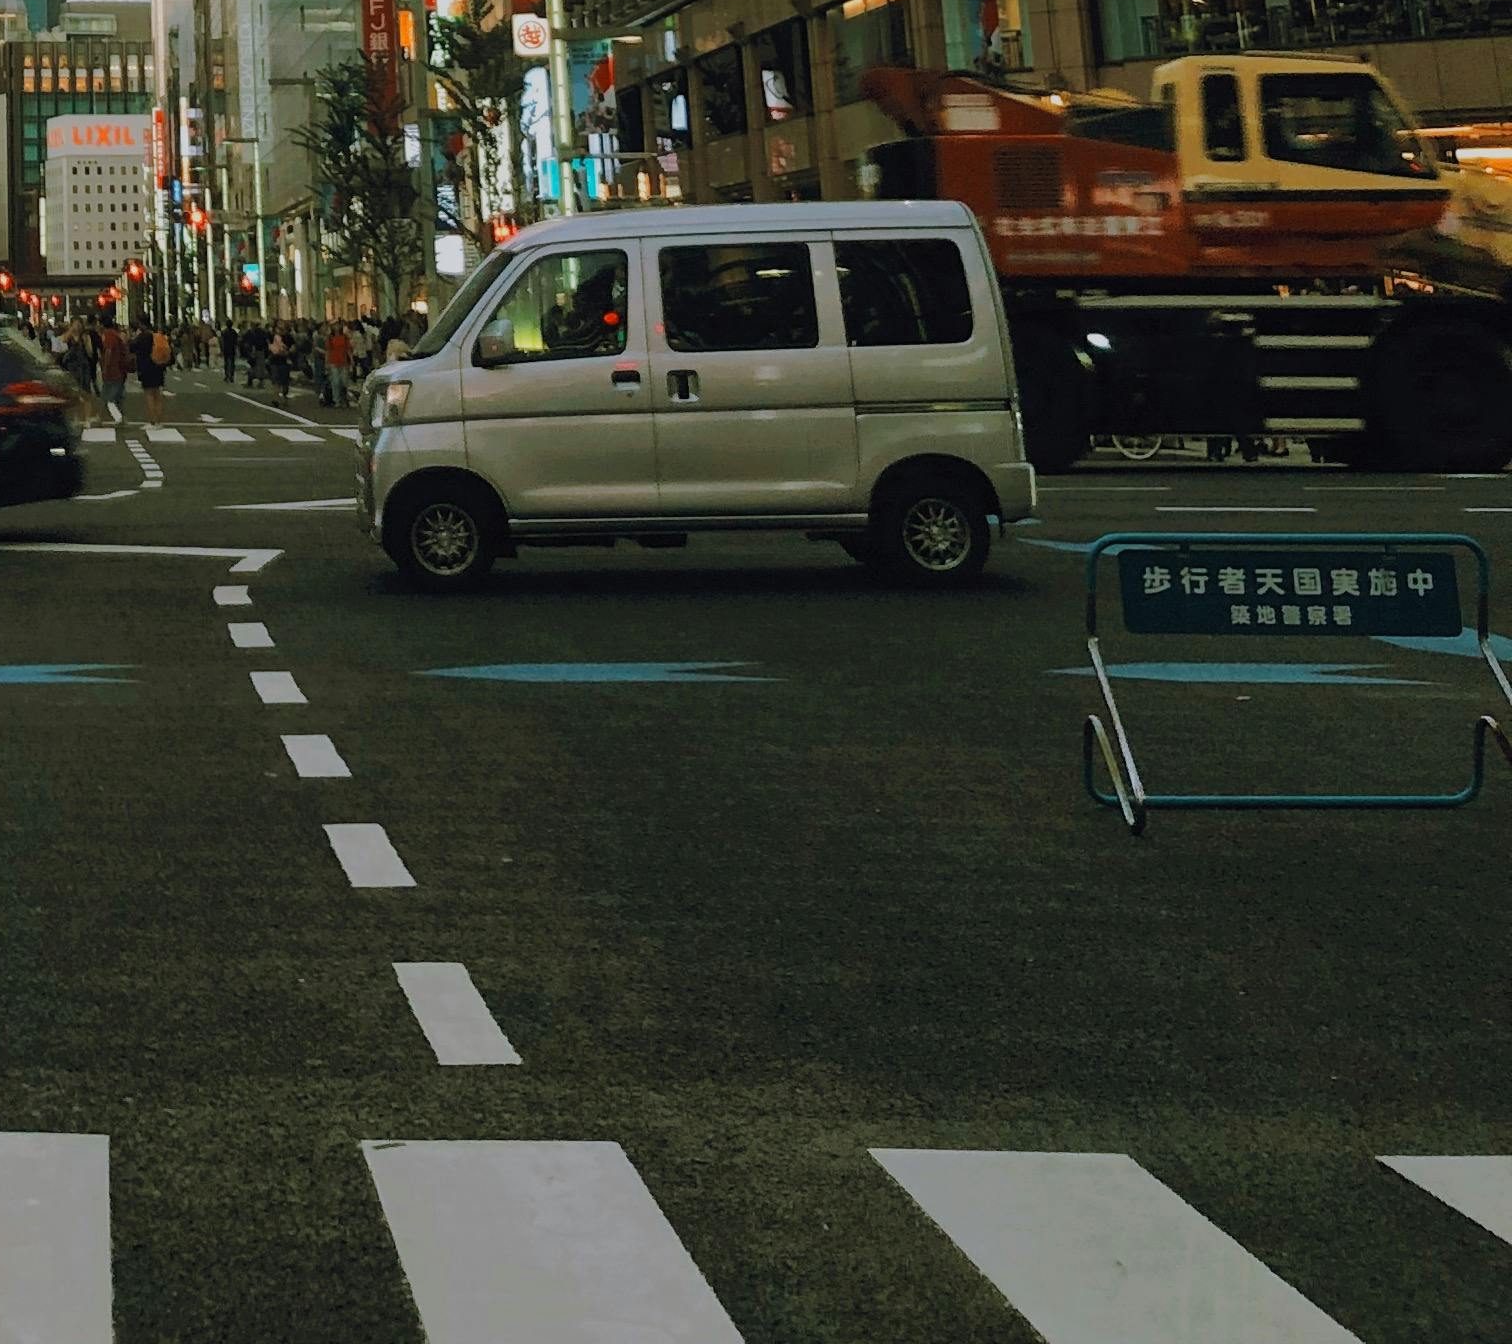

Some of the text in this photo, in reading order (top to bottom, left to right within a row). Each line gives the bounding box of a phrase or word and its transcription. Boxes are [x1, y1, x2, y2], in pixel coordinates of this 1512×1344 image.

[72, 125, 136, 146] LIXIL
[1142, 566, 1434, 597] 歩行者天国実施中
[1230, 604, 1352, 626] 築地警察署
